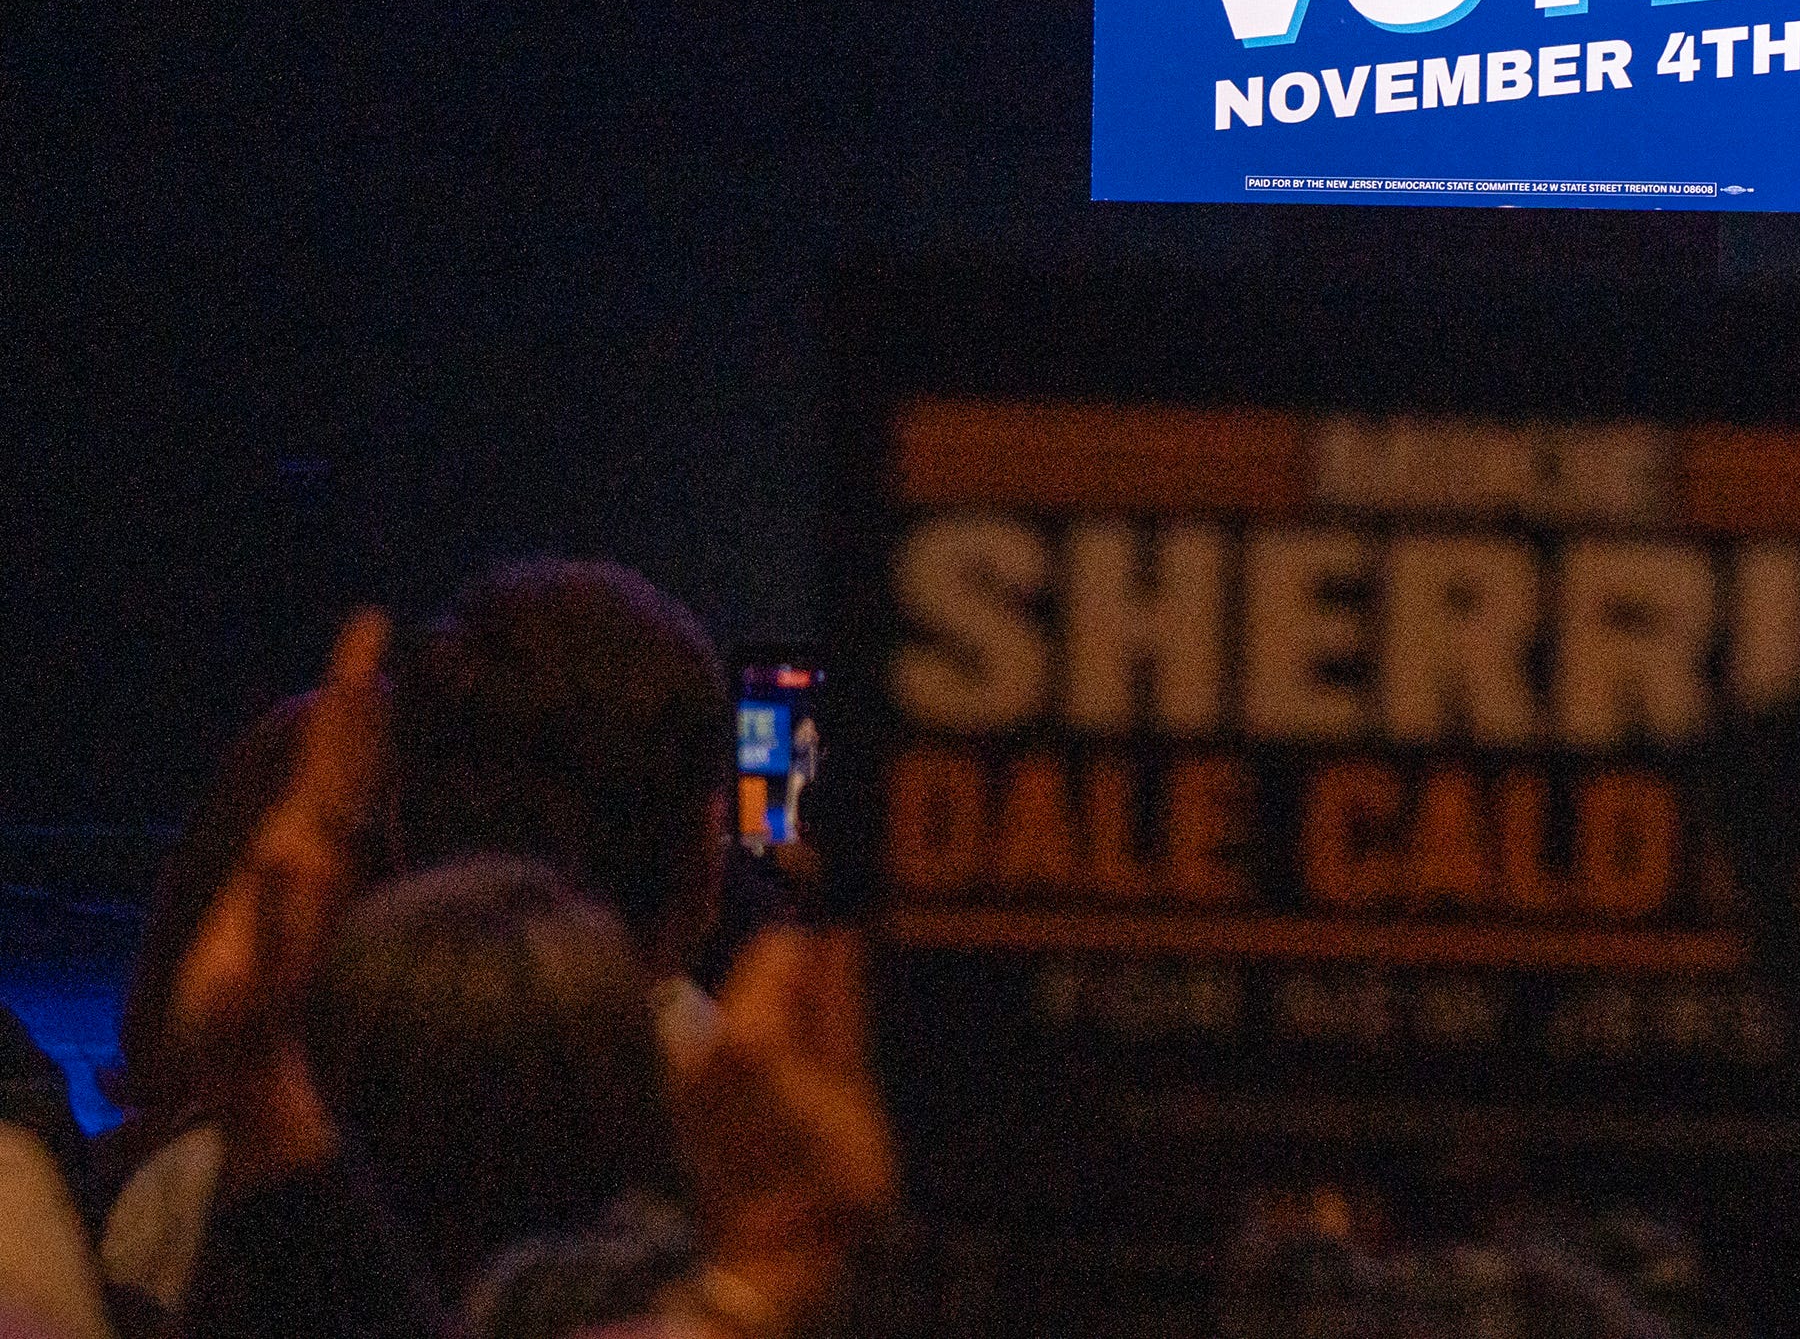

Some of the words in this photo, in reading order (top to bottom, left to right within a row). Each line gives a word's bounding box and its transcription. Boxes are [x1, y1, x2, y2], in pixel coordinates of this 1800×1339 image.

[1214, 39, 1633, 131] NOVEMBER
[1248, 178, 1270, 188] PAID
[1272, 178, 1291, 188] FOR
[1293, 178, 1304, 188] BY
[1306, 179, 1324, 189] THE
[1326, 179, 1348, 189] NEW
[1349, 179, 1383, 190] JERSEY
[1385, 180, 1445, 191] DEMOCRATIC
[1447, 181, 1474, 191] STATE
[1476, 181, 1530, 192] COMMITTEE
[1532, 182, 1548, 192] 142
[1549, 182, 1559, 192] W
[1560, 183, 1587, 193] STATE
[1589, 183, 1622, 193] STREET
[1624, 184, 1667, 194] TRENTON
[1669, 184, 1682, 194] NJ
[1683, 185, 1713, 194] 08608
[882, 747, 1255, 906] DALE
[1298, 757, 1745, 924] CALD
